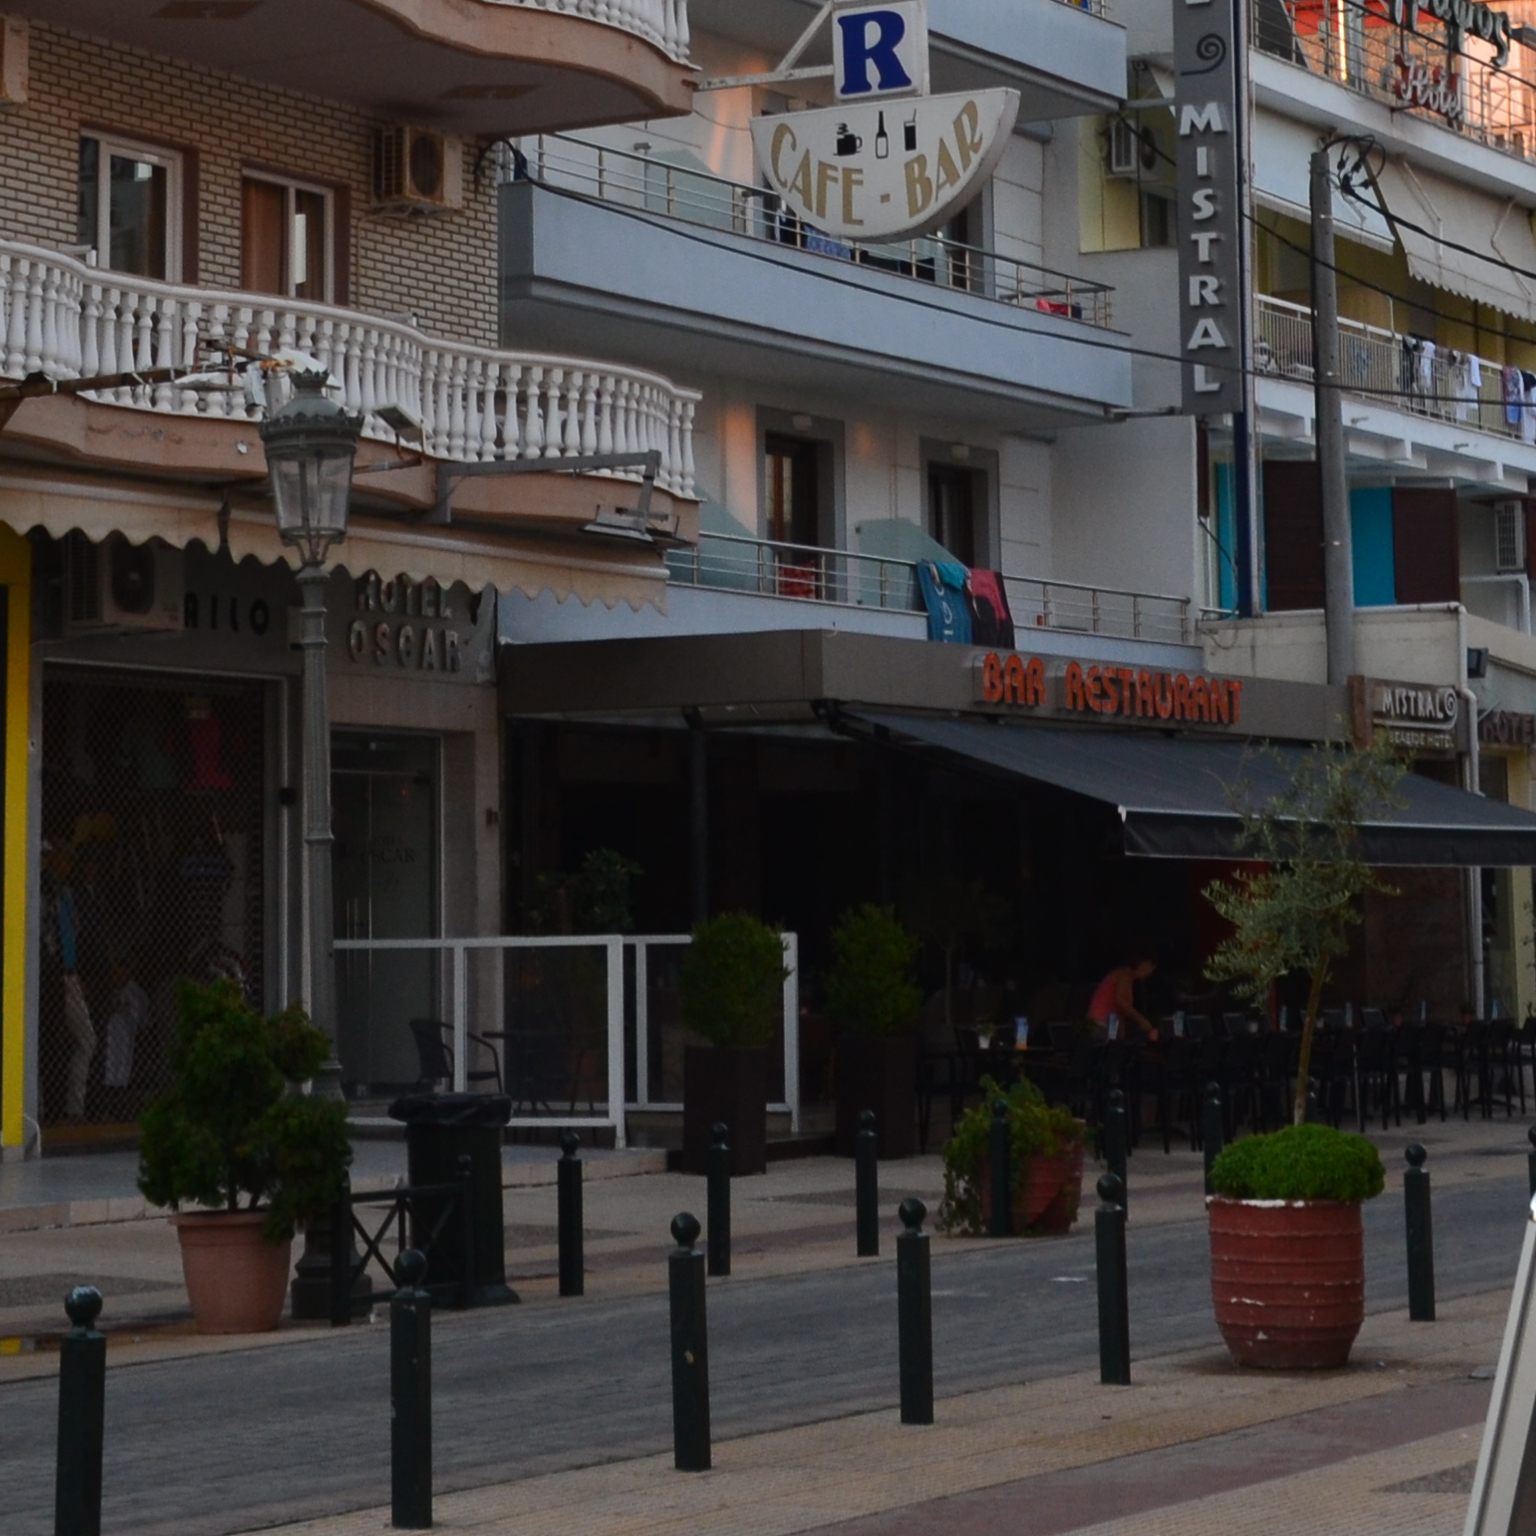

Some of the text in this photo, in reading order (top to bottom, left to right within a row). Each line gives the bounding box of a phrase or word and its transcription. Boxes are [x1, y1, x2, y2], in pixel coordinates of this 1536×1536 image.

[769, 122, 864, 226] CAFE
[903, 98, 983, 221] BAR
[1179, 99, 1227, 396] MISTRAL
[349, 619, 460, 672] OSCAR
[982, 650, 1244, 725] BAR RESTAURANT
[1381, 687, 1445, 720] MISTRAL
